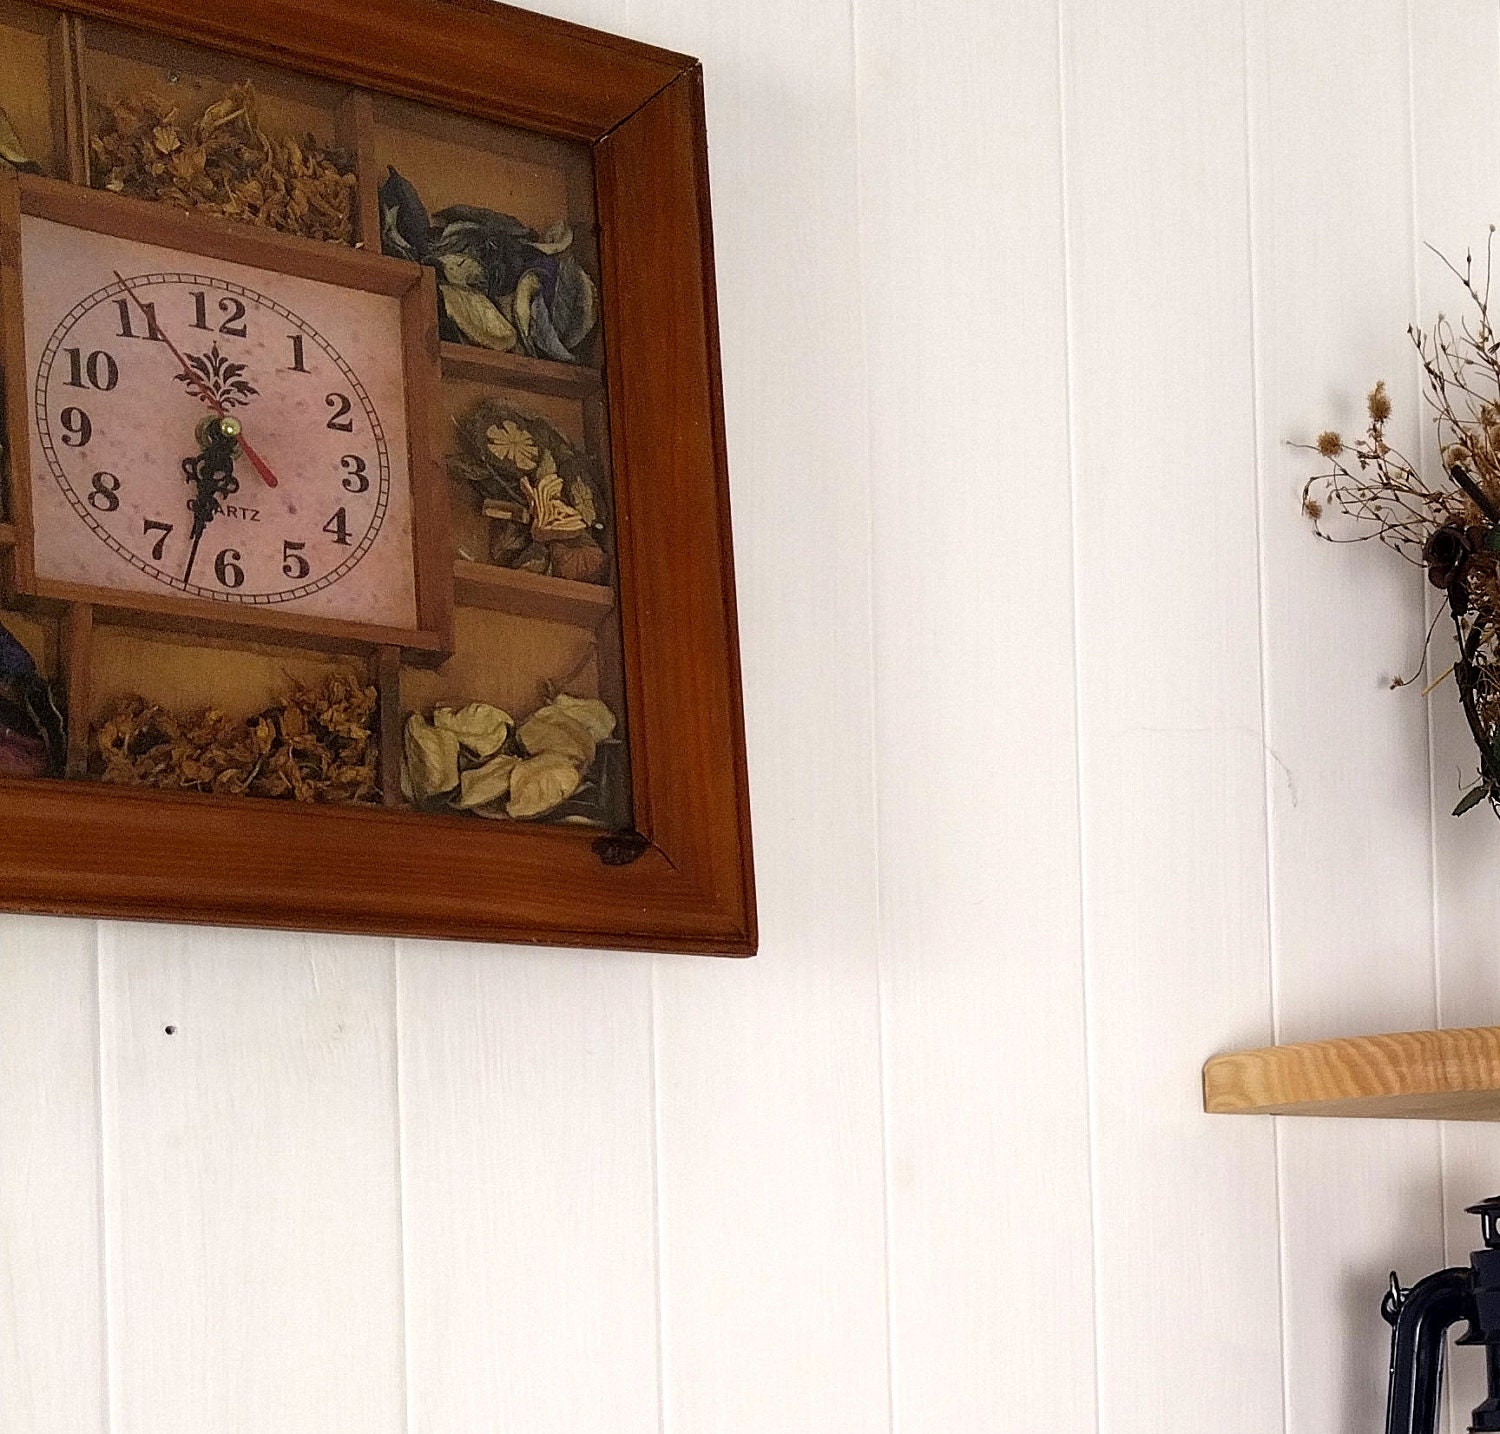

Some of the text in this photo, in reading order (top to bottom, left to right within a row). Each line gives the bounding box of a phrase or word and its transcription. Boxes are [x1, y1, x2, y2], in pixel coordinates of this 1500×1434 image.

[112, 298, 165, 342] 11
[188, 291, 248, 338] 12
[62, 348, 119, 392] 10
[286, 334, 312, 374] 1
[60, 406, 92, 447] 9
[325, 393, 353, 433] 2
[87, 471, 120, 512] 8
[341, 454, 369, 493] 3
[186, 499, 261, 522] ARTZ
[322, 506, 353, 546] 4
[143, 519, 174, 561] 7
[282, 540, 310, 579] 5
[214, 548, 245, 588] 6
